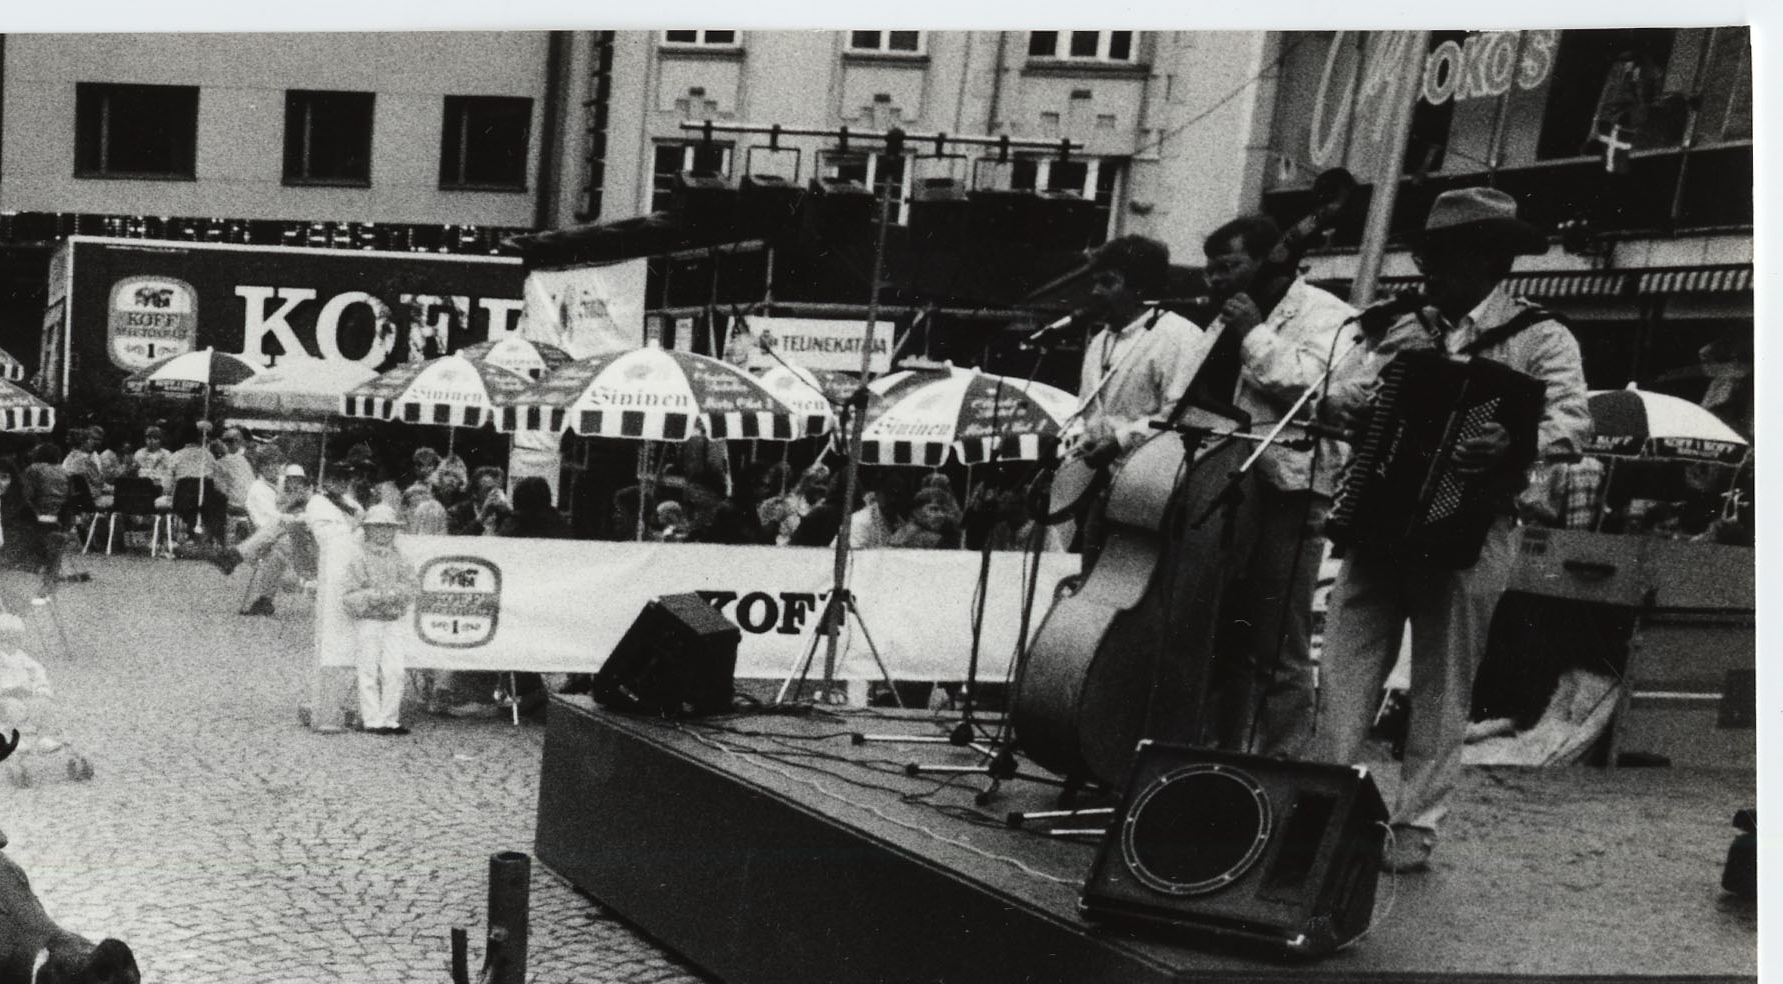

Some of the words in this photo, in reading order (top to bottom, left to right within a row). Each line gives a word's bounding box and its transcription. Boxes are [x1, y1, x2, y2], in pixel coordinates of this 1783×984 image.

[127, 312, 179, 326] KOFF
[782, 335, 887, 353] TELINEKATJA
[590, 385, 688, 406] Sininen
